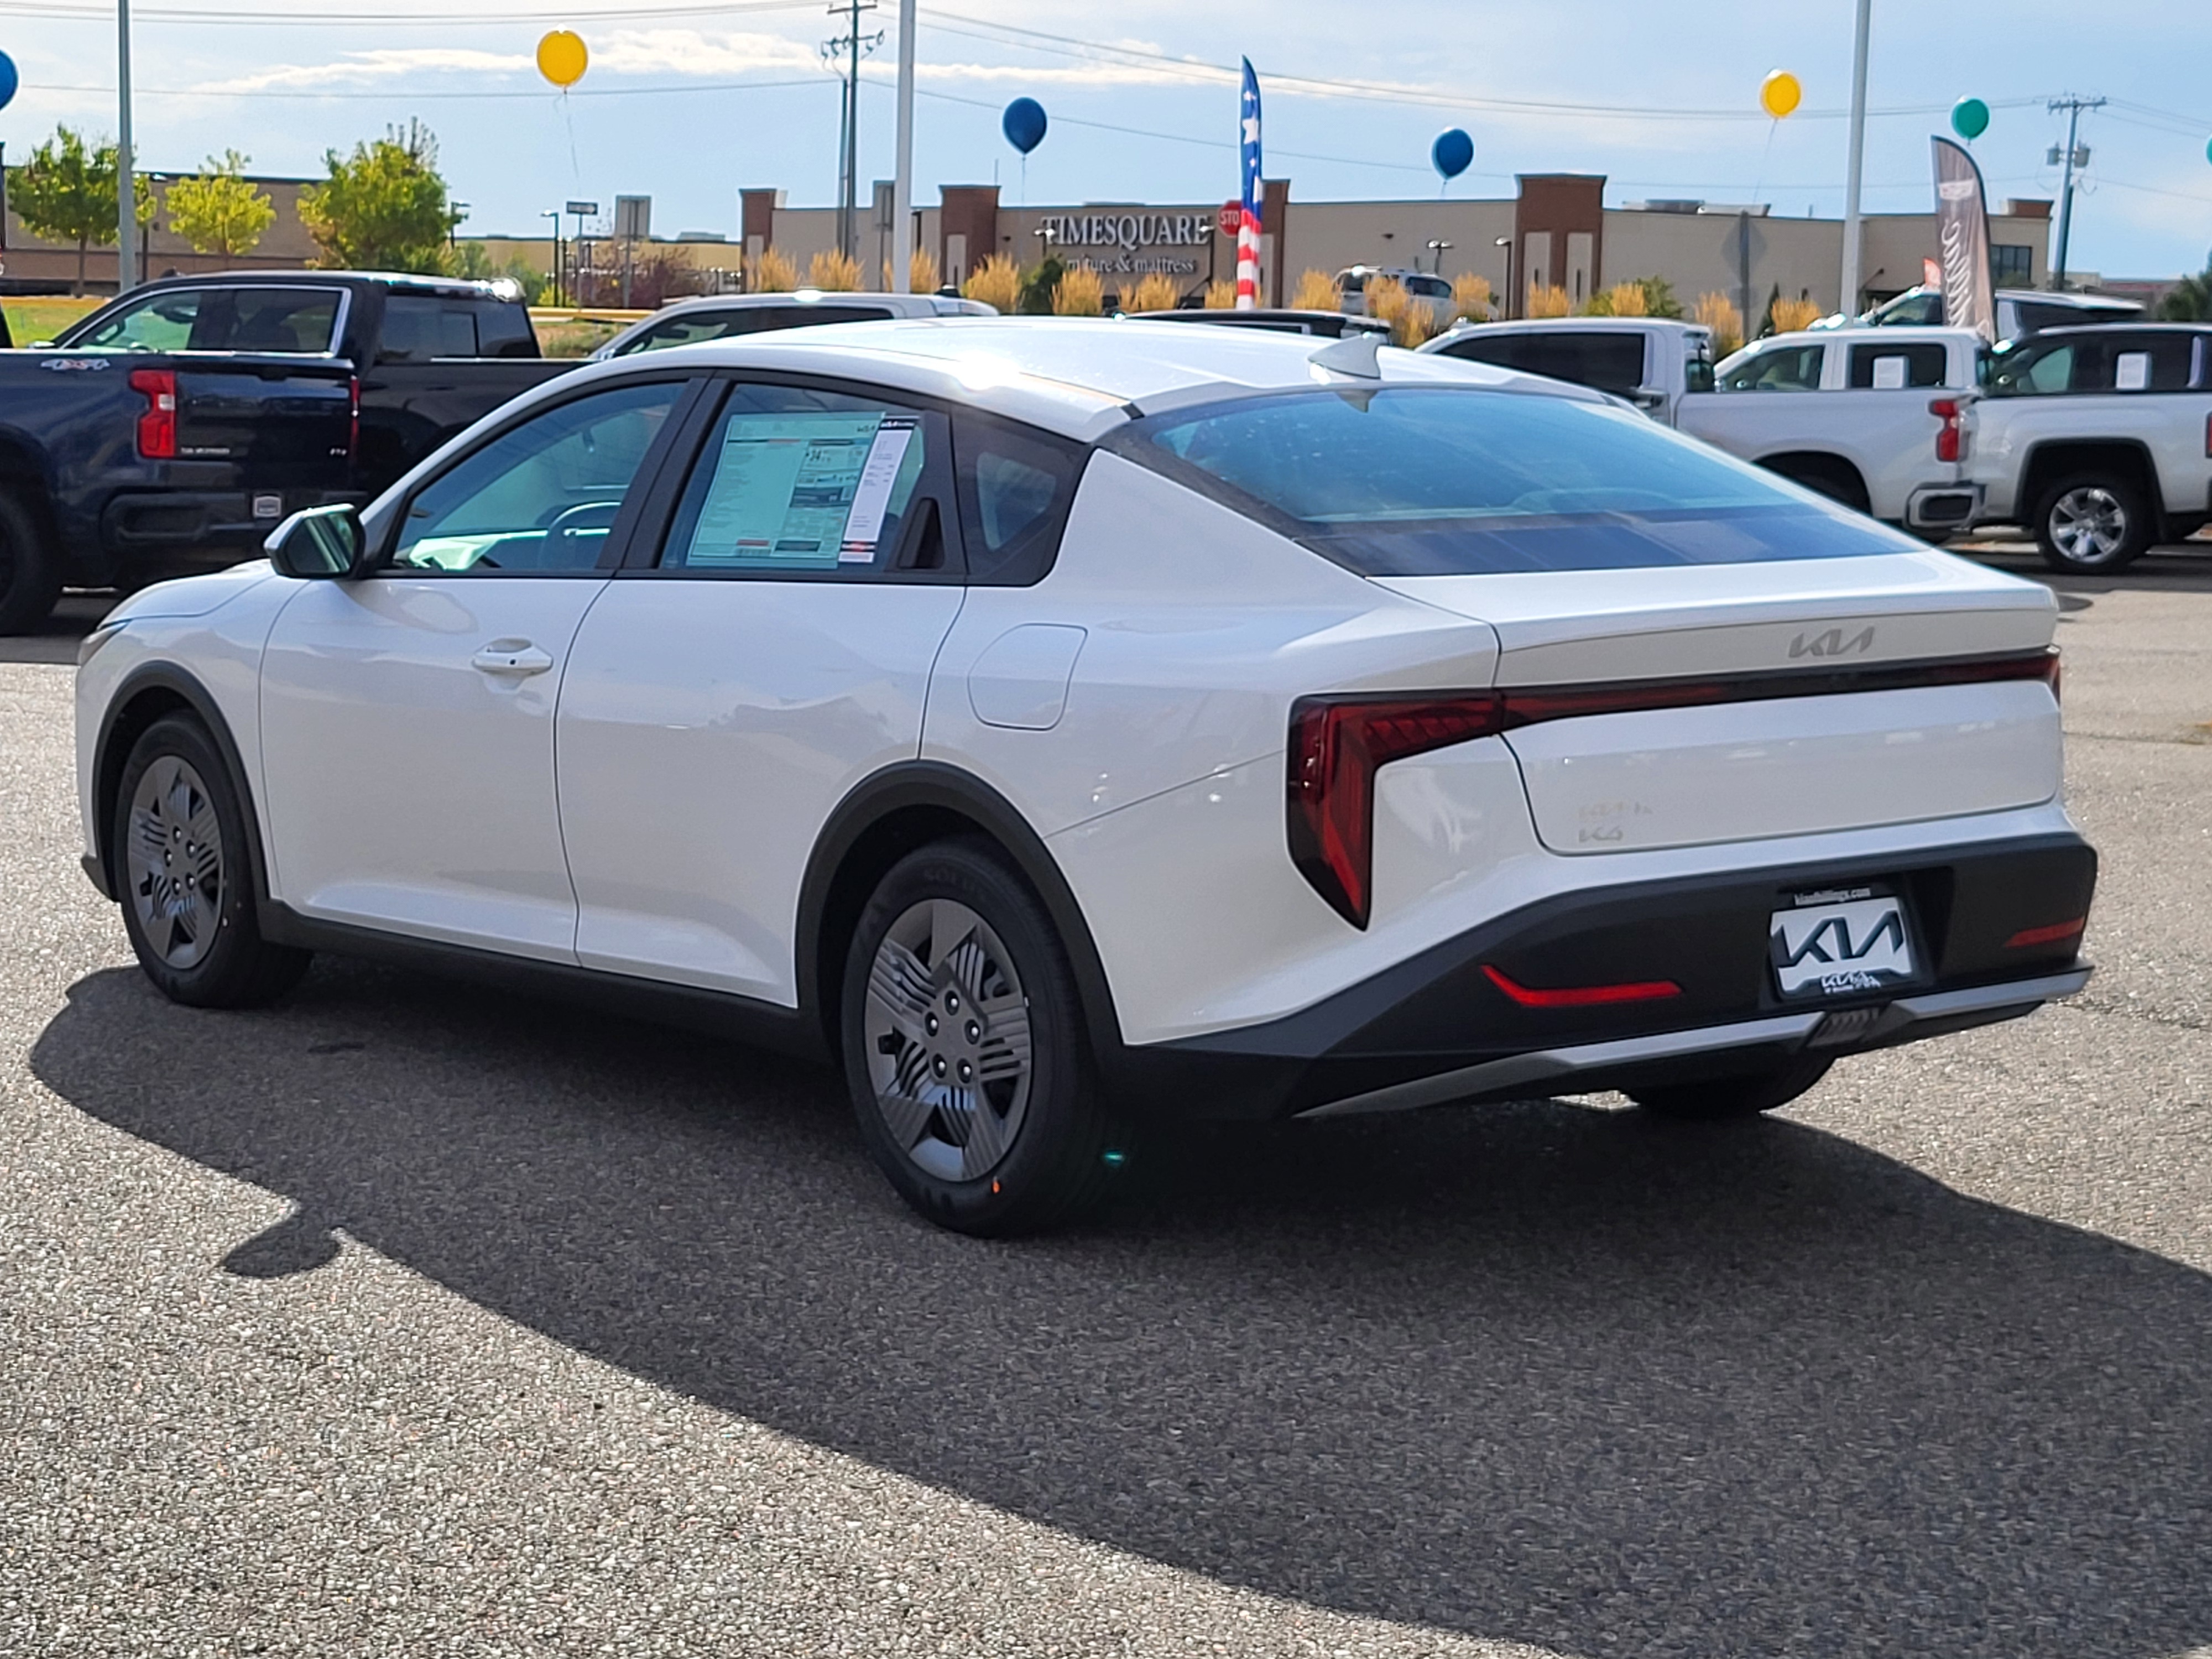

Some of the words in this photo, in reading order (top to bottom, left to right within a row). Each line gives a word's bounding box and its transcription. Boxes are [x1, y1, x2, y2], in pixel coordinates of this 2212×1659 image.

[1041, 215, 1208, 250] TIMESQUARE
[1220, 210, 1240, 225] STO
[1115, 252, 1130, 272] &
[1788, 626, 1875, 658] KIA
[1771, 910, 1904, 968] KIA
